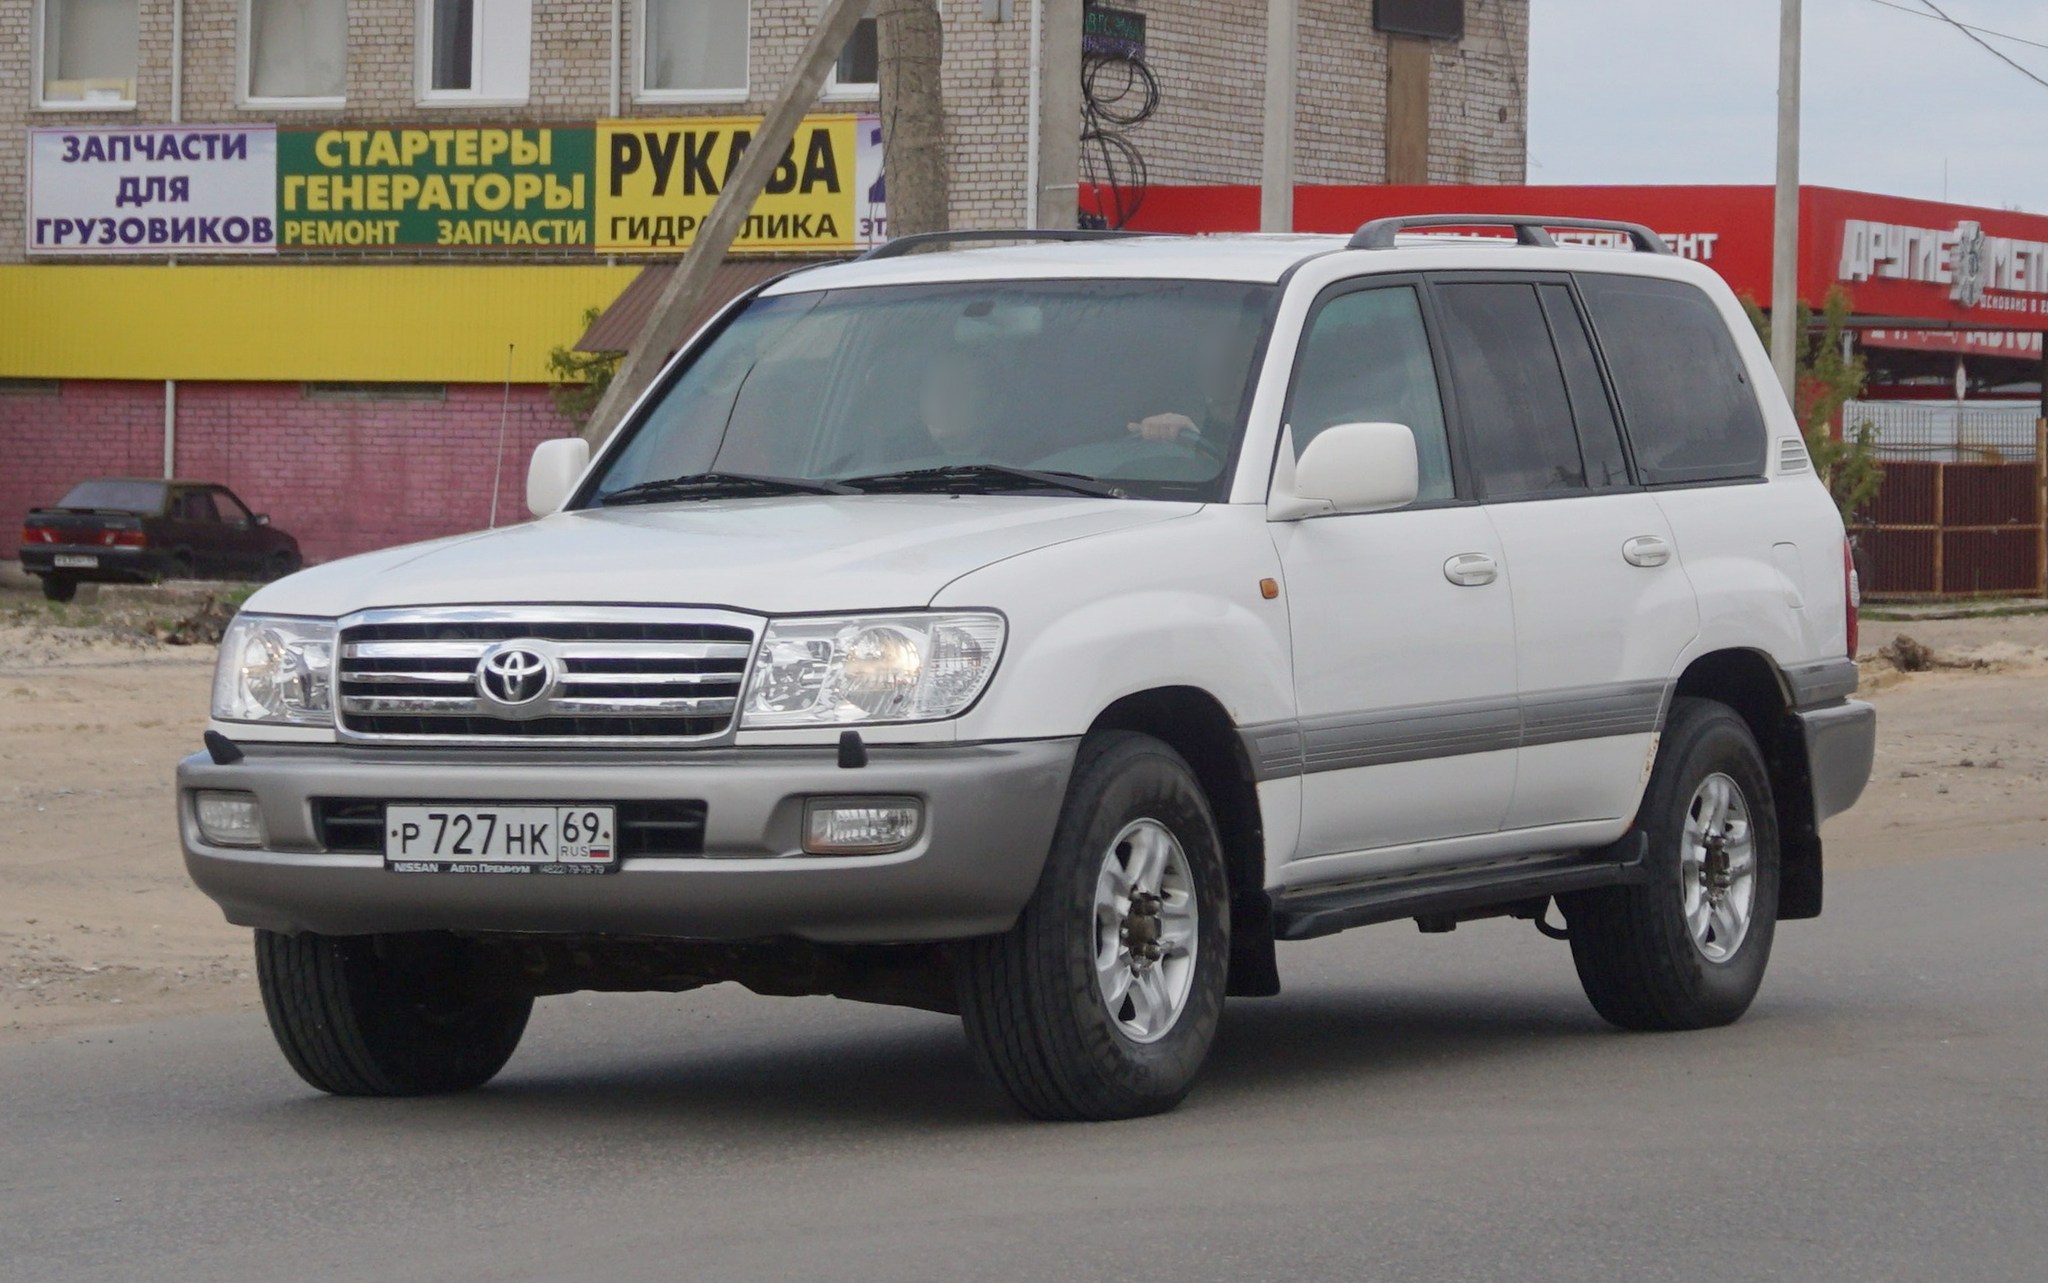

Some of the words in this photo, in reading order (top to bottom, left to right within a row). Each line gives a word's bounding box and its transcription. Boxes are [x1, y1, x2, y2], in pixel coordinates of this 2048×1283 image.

[61, 133, 248, 163] ЗАПЧАСТИ
[314, 129, 552, 168] СТАРТЕРЫ
[115, 175, 190, 208] ДЛЯ
[283, 173, 586, 213] ГЕНЕРАТОРЫ
[36, 216, 274, 246] ГРУЗОВИКОВ
[284, 219, 401, 246] РЕМОНТ
[436, 218, 587, 247] ЗАПЧАСТИ
[610, 213, 839, 247] ГИДРЛИКА
[860, 218, 888, 237] ЭТ
[1839, 219, 1954, 284] ДРУГИЕ
[562, 811, 600, 844] 69
[560, 846, 588, 857] RUS
[394, 862, 439, 873] NISSAN
